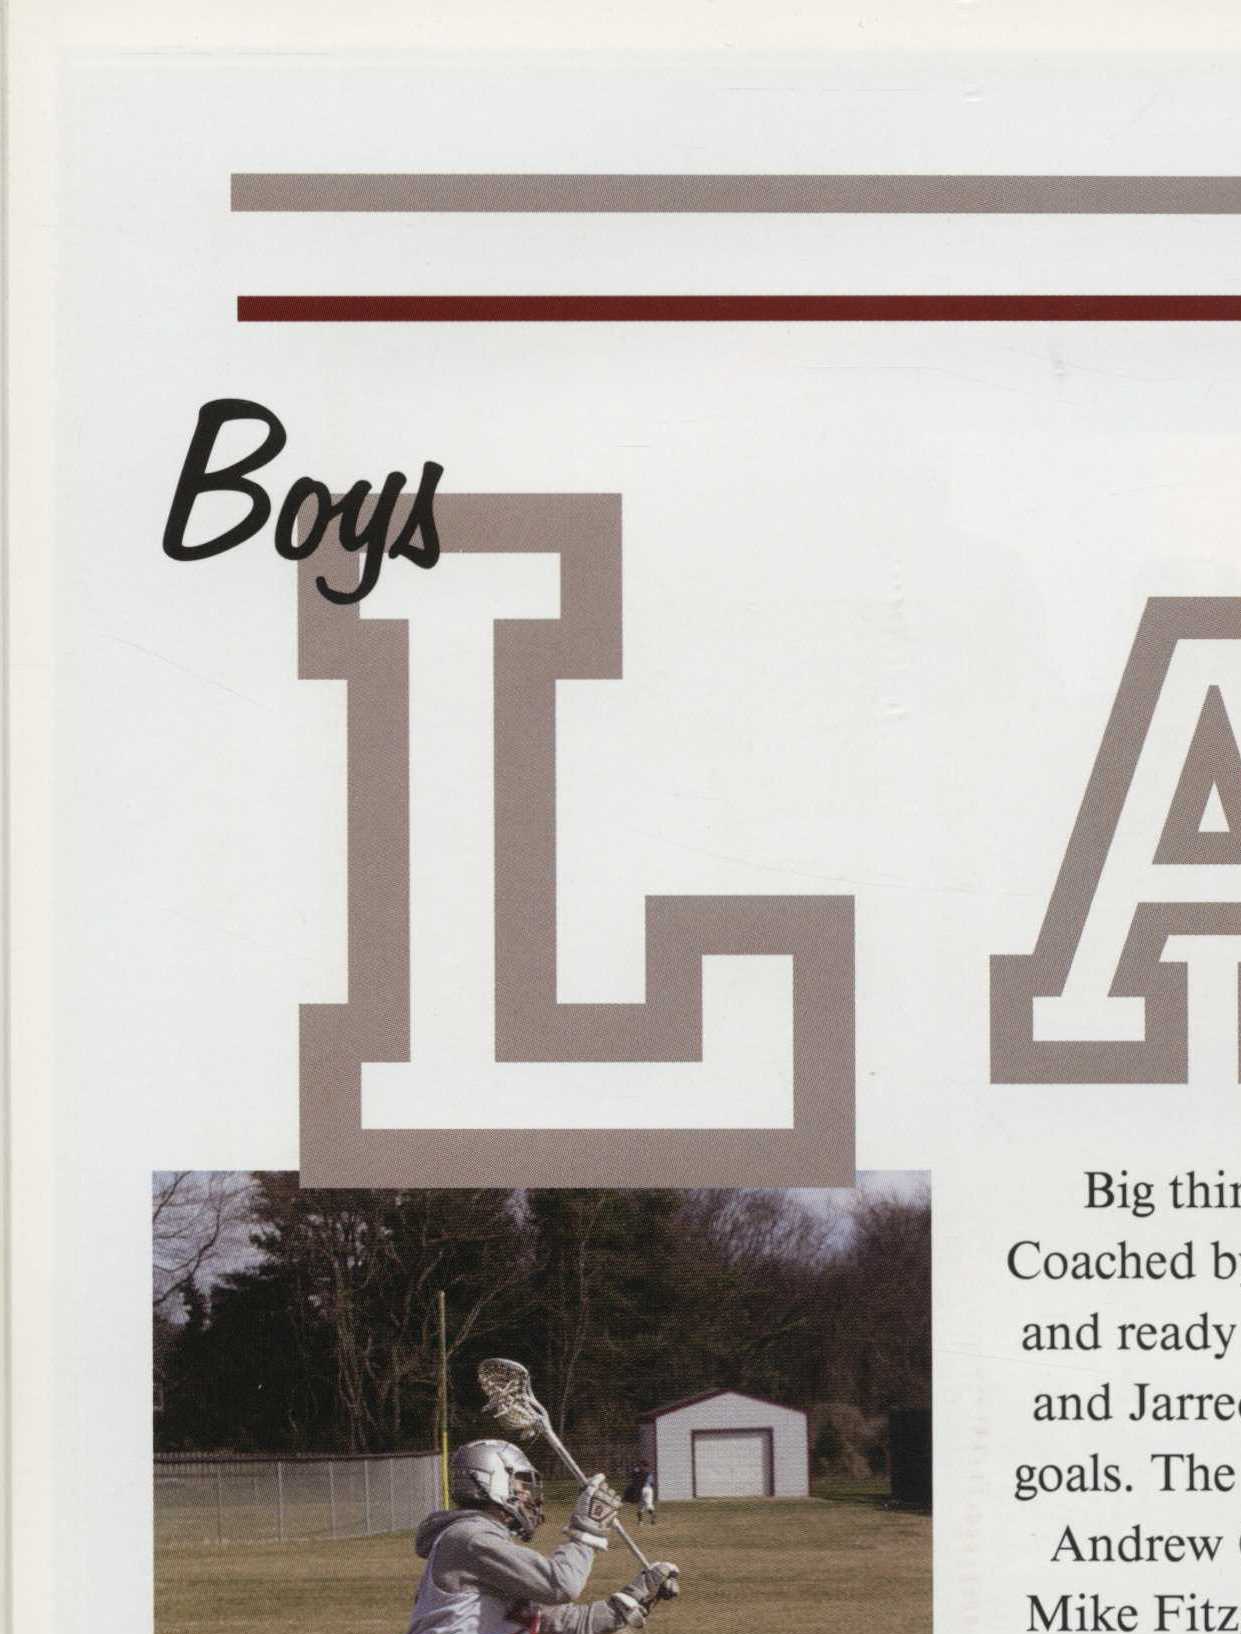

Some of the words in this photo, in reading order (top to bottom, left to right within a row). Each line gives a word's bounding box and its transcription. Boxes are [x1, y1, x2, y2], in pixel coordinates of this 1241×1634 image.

[162, 397, 444, 606] Boys
[1084, 1169, 1156, 1218] Big
[1007, 1240, 1196, 1280] Coached
[1022, 1311, 1102, 1351] and
[1117, 1311, 1237, 1360] ready
[1033, 1382, 1113, 1422] and
[1014, 1452, 1133, 1502] goals.
[1150, 1452, 1235, 1493] The
[1050, 1524, 1224, 1563] Andrew
[1026, 1592, 1138, 1633] Mike
